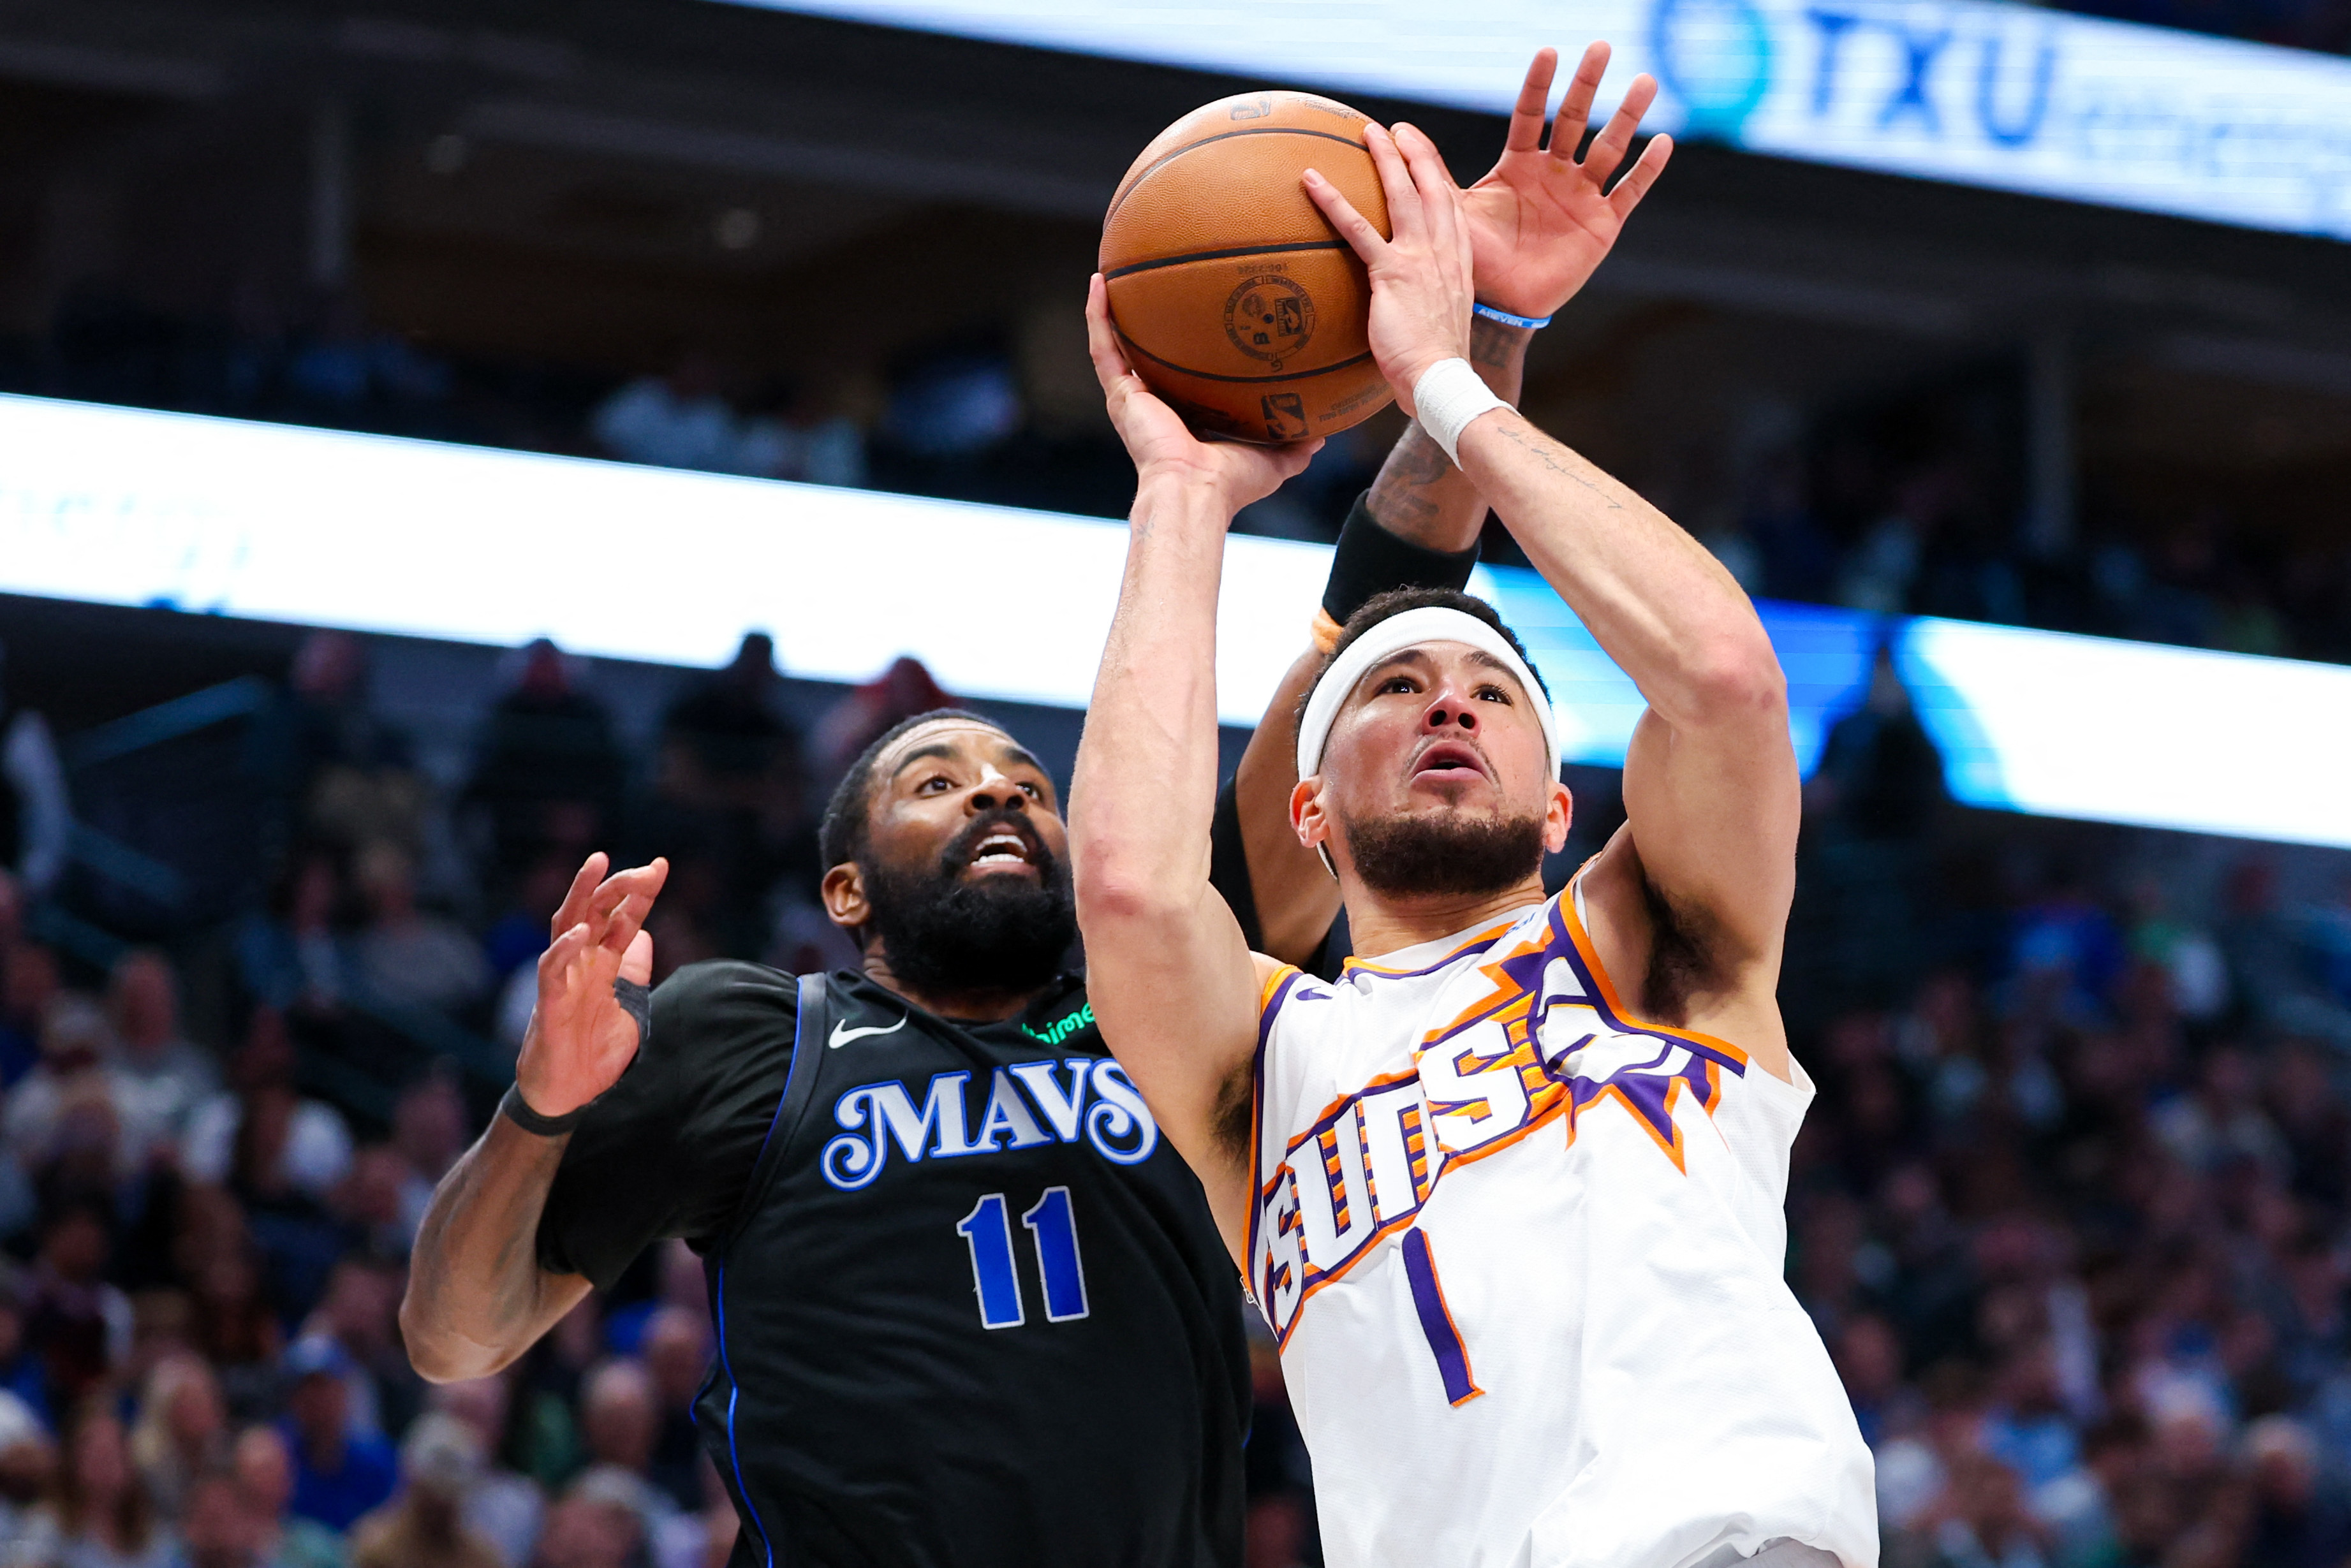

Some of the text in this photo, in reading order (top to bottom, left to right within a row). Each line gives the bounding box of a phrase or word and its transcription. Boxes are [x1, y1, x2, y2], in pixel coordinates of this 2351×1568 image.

[1806, 5, 2055, 149] TXU
[820, 1057, 1159, 1192] MAVS
[957, 1185, 1089, 1330] 11
[1402, 1226, 1485, 1408] 1
